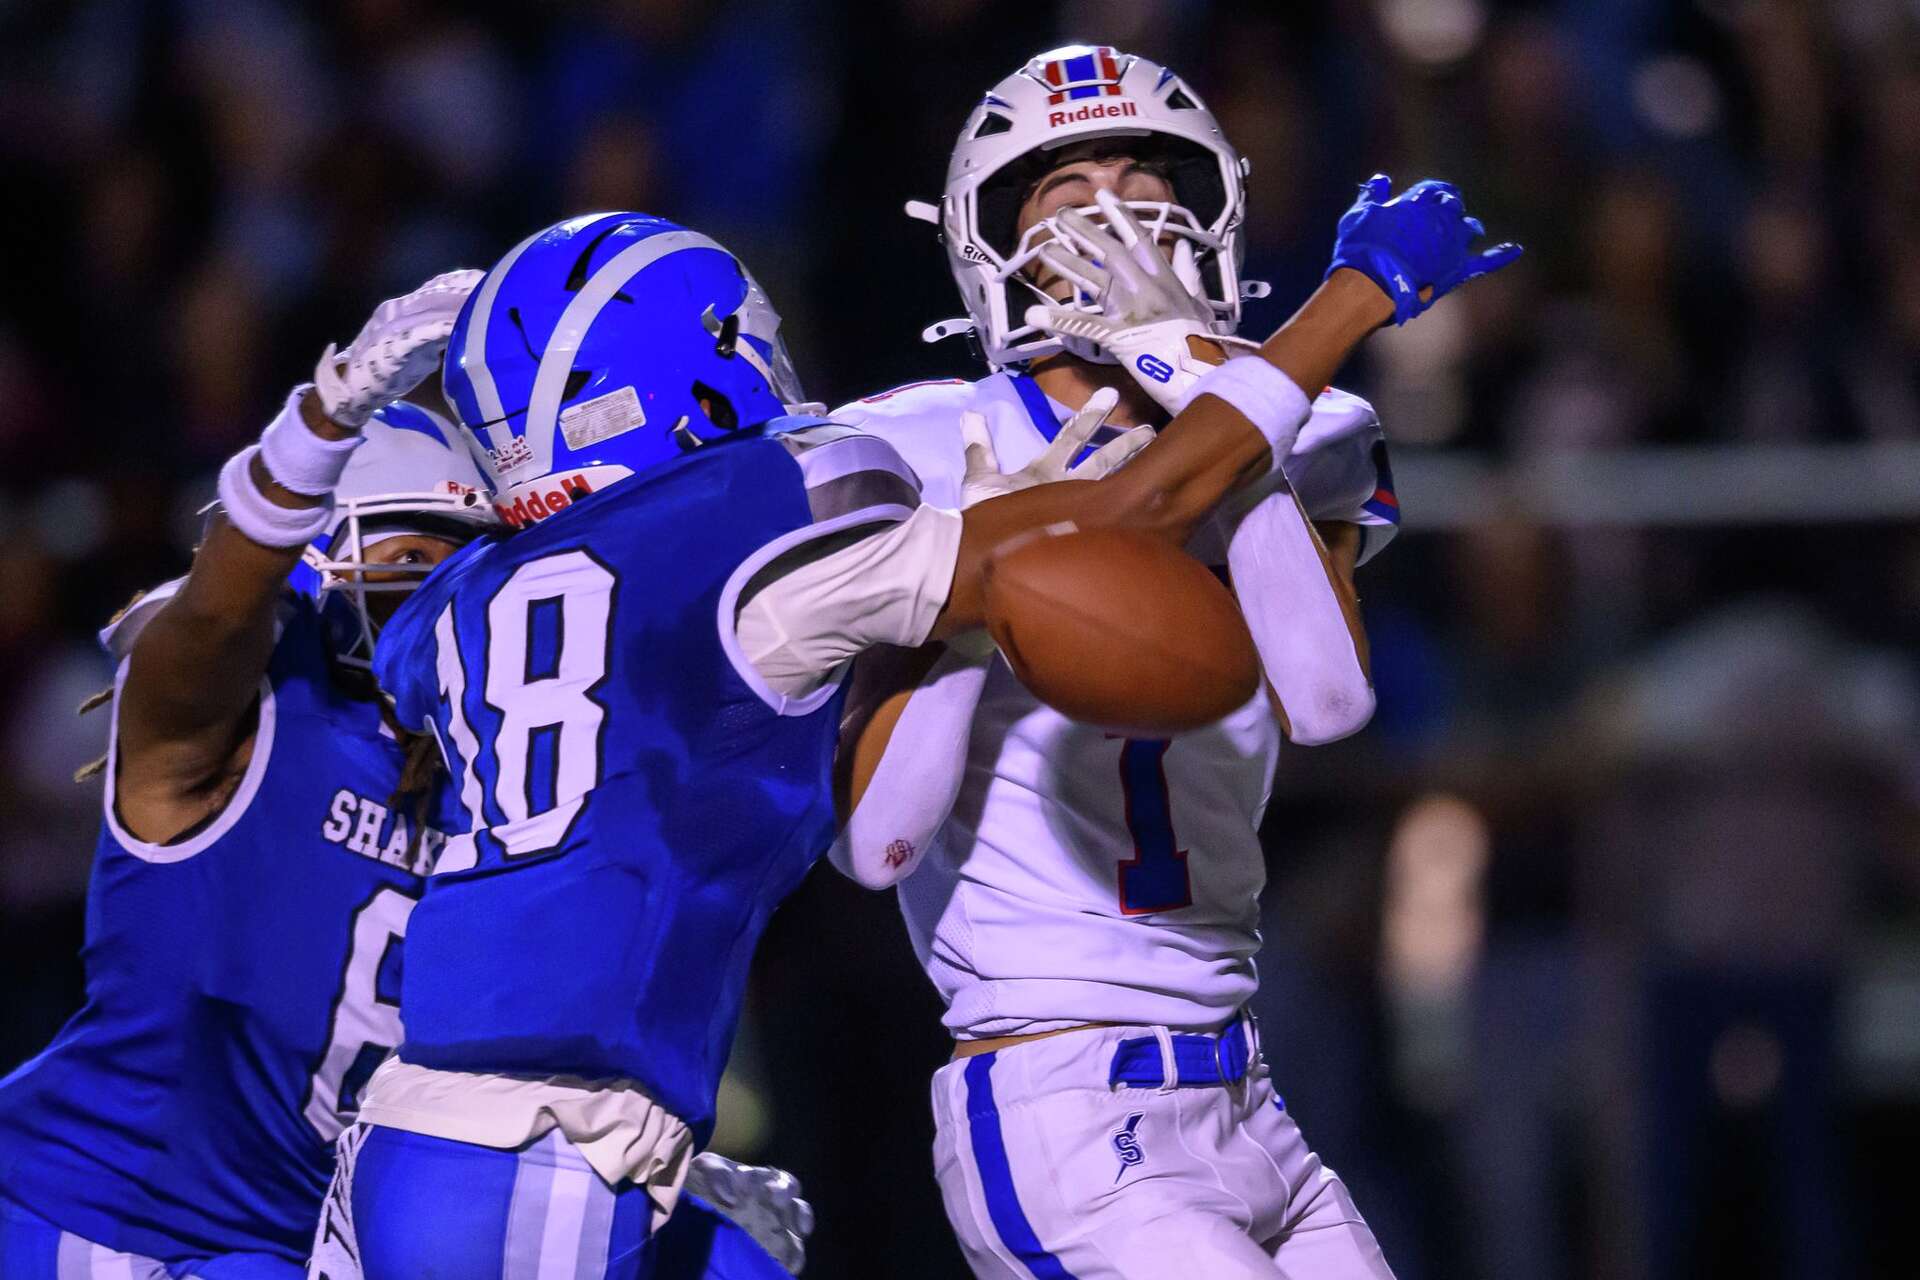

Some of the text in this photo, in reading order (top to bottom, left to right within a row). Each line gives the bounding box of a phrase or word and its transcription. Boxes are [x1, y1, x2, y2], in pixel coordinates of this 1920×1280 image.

[1049, 102, 1136, 128] Riddell
[432, 547, 618, 877] 18
[322, 788, 446, 877] SHAK
[1105, 733, 1192, 915] 1
